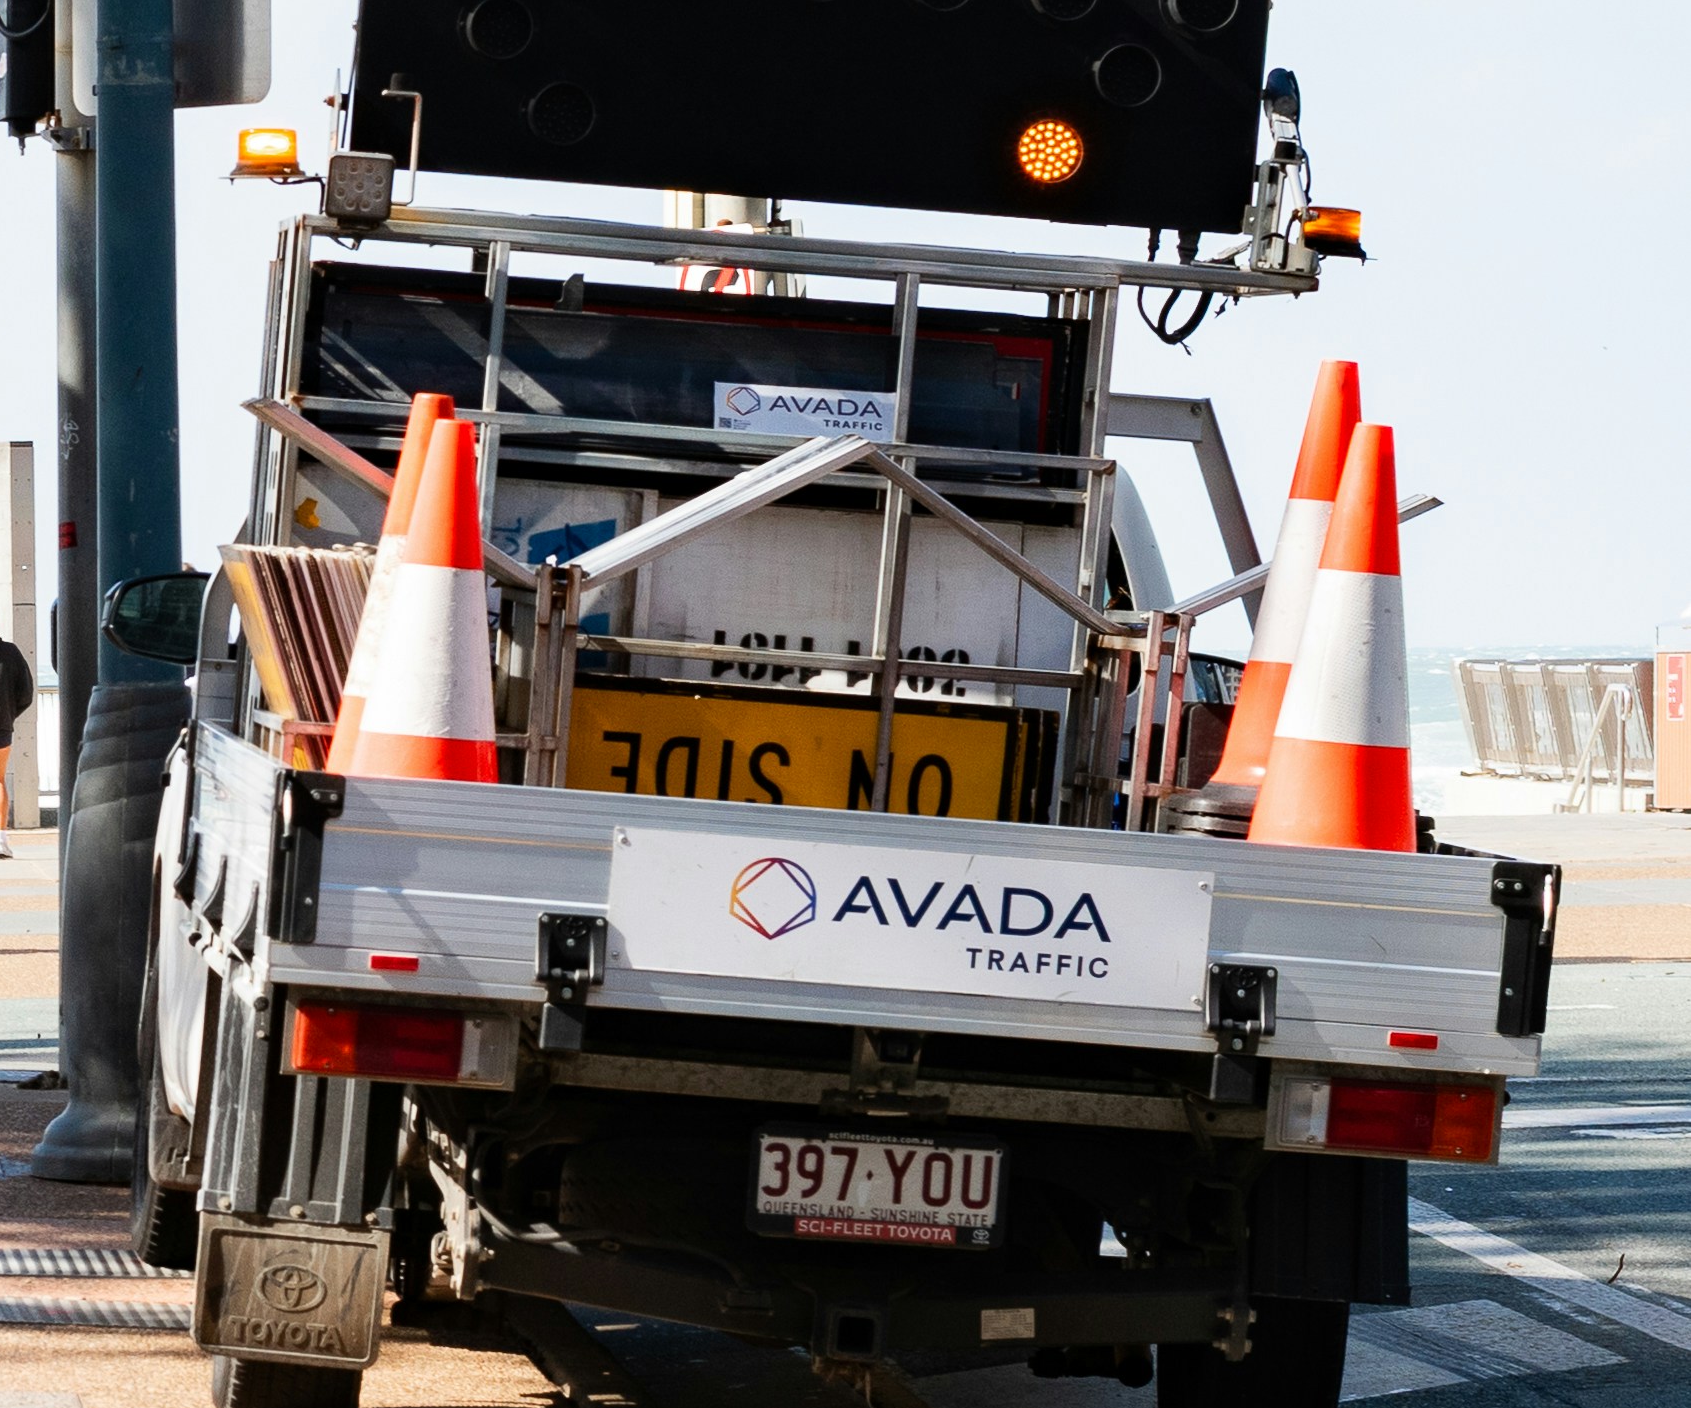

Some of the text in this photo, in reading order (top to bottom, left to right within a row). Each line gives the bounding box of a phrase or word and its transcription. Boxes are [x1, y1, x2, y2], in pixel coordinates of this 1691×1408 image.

[768, 395, 882, 419] AVADA
[823, 419, 883, 431] TRAFFIC
[603, 730, 953, 816] ON SIDE
[832, 875, 1112, 942] AVADA
[966, 947, 1110, 979] TRAFFIC
[828, 1131, 935, 1146] scifleettoyota.com.au
[761, 1142, 994, 1210] 397 YOU
[763, 1200, 855, 1218] QUEENSLAND
[870, 1207, 939, 1225] SUNSHINE
[947, 1212, 989, 1228] STATE
[798, 1219, 953, 1241] SCI-FLEET TOYOTA
[228, 1314, 347, 1355] TOYOTA
